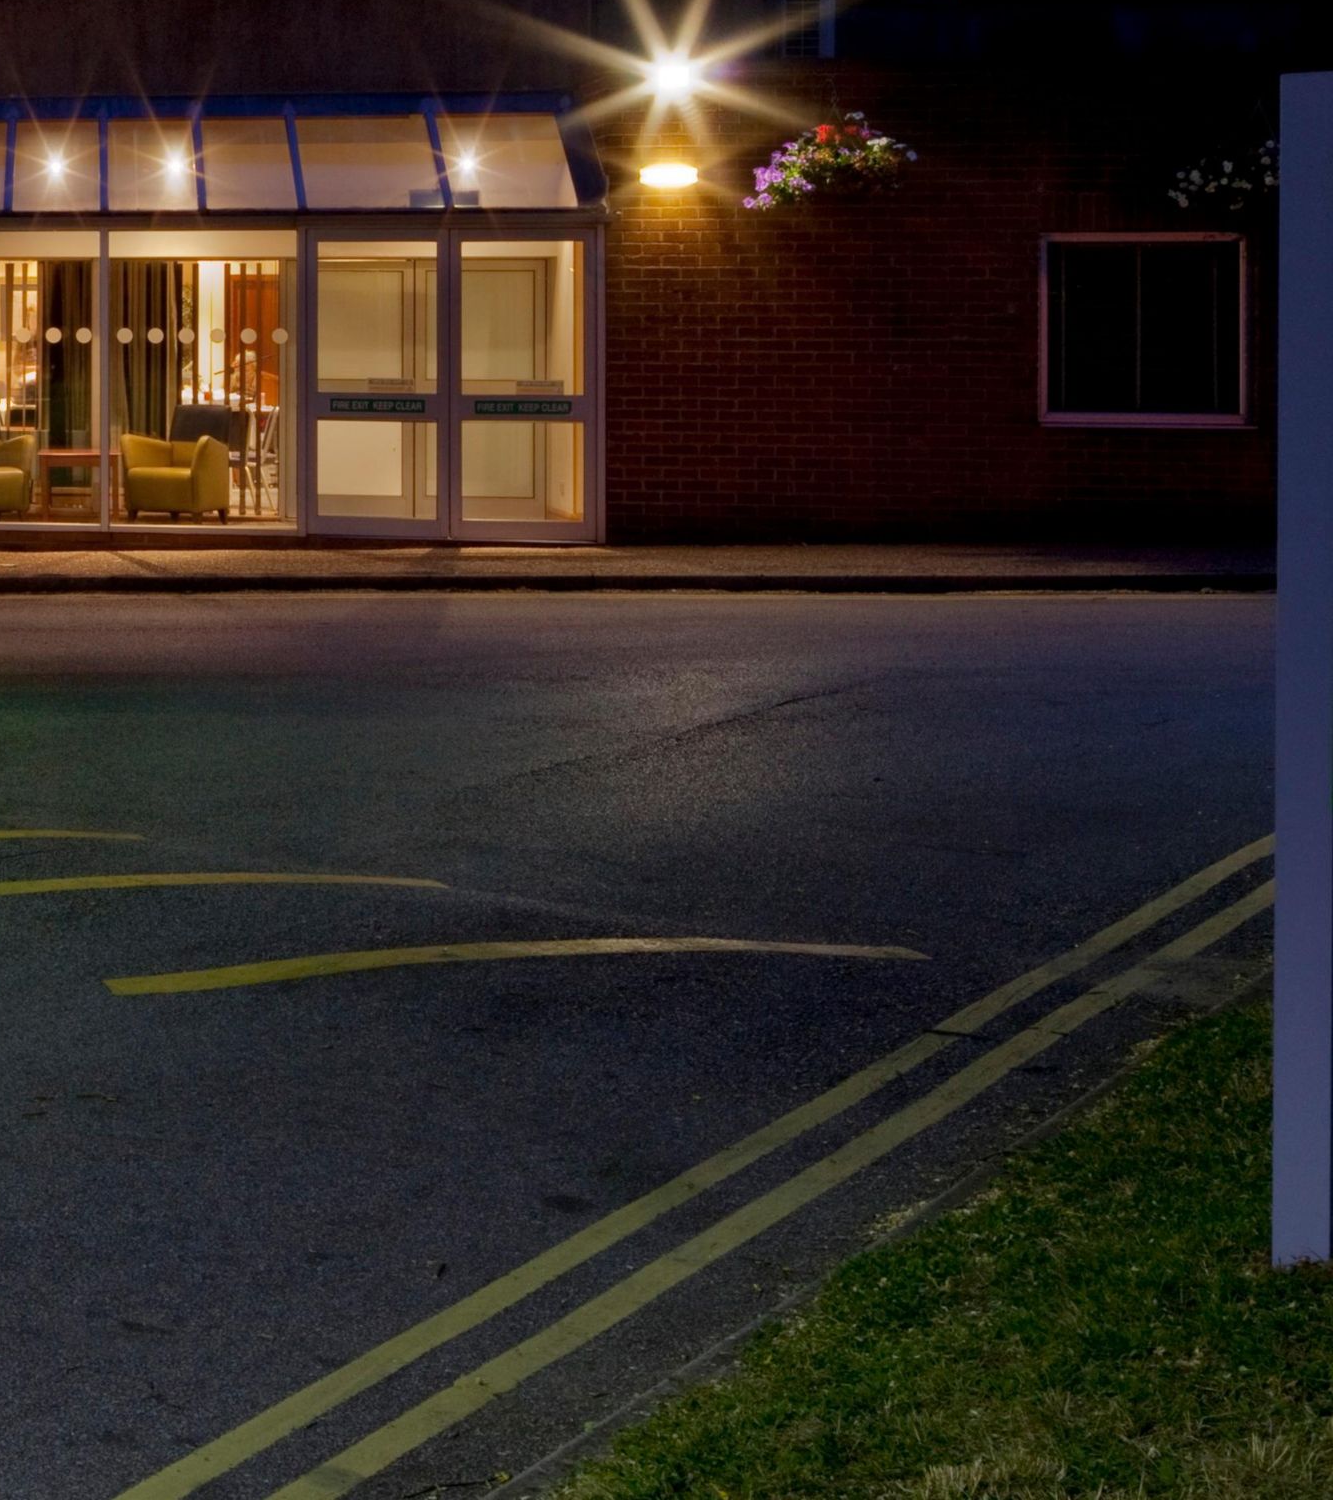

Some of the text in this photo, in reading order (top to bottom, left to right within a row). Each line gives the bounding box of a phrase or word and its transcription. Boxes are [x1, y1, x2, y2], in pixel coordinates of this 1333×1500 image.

[332, 400, 422, 411] FIRE EXIT KEEP CLEAR
[477, 402, 569, 412] FIRE EXIT KEEP CLEAR
